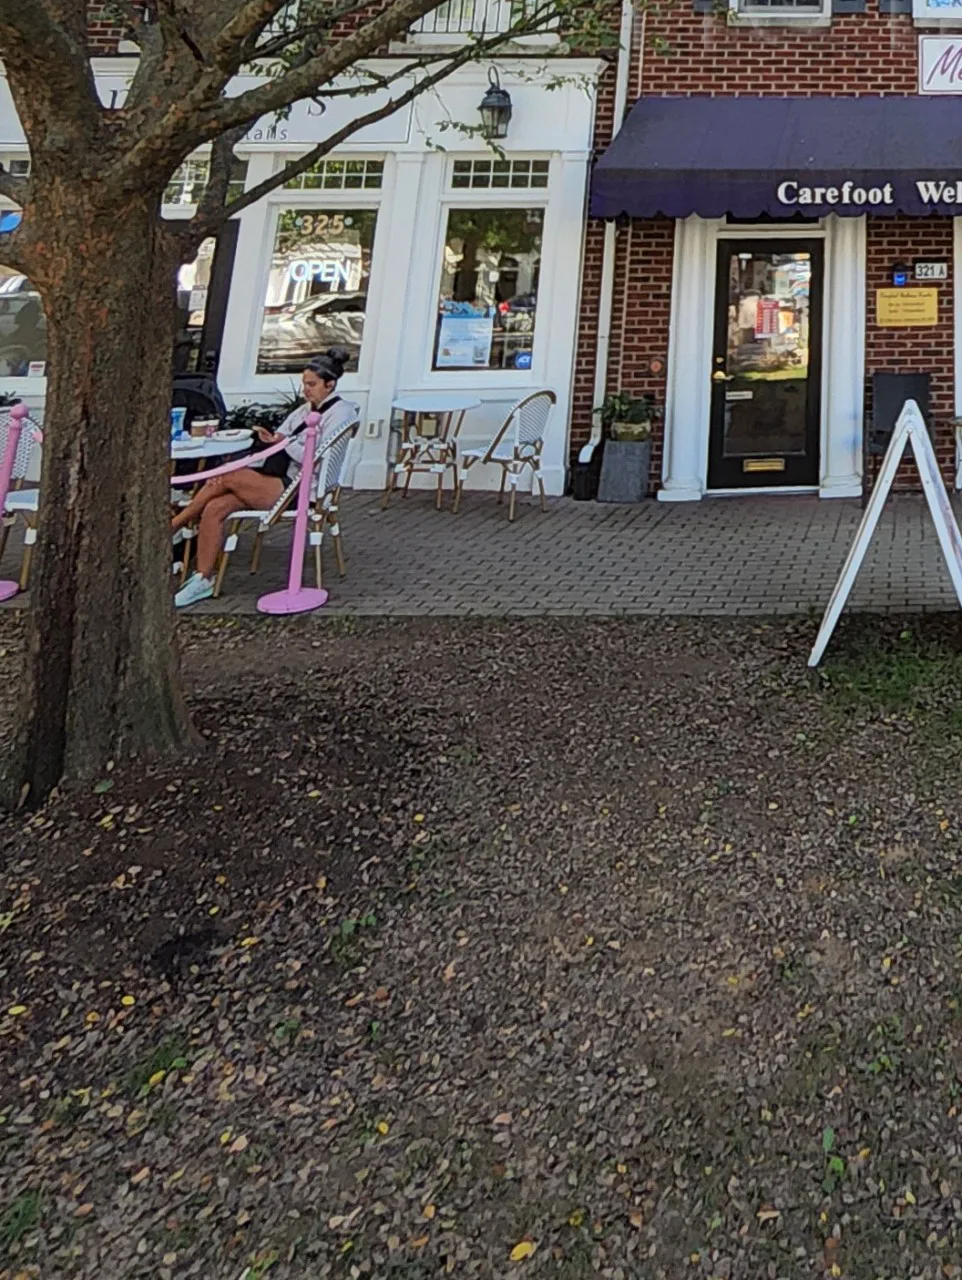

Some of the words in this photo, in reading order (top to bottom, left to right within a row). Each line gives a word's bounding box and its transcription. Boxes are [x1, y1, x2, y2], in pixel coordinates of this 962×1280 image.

[777, 181, 893, 204] Carefoot
[300, 214, 345, 235] 325
[290, 259, 351, 283] OPEN
[917, 265, 935, 277] 321
[938, 265, 945, 276] A
